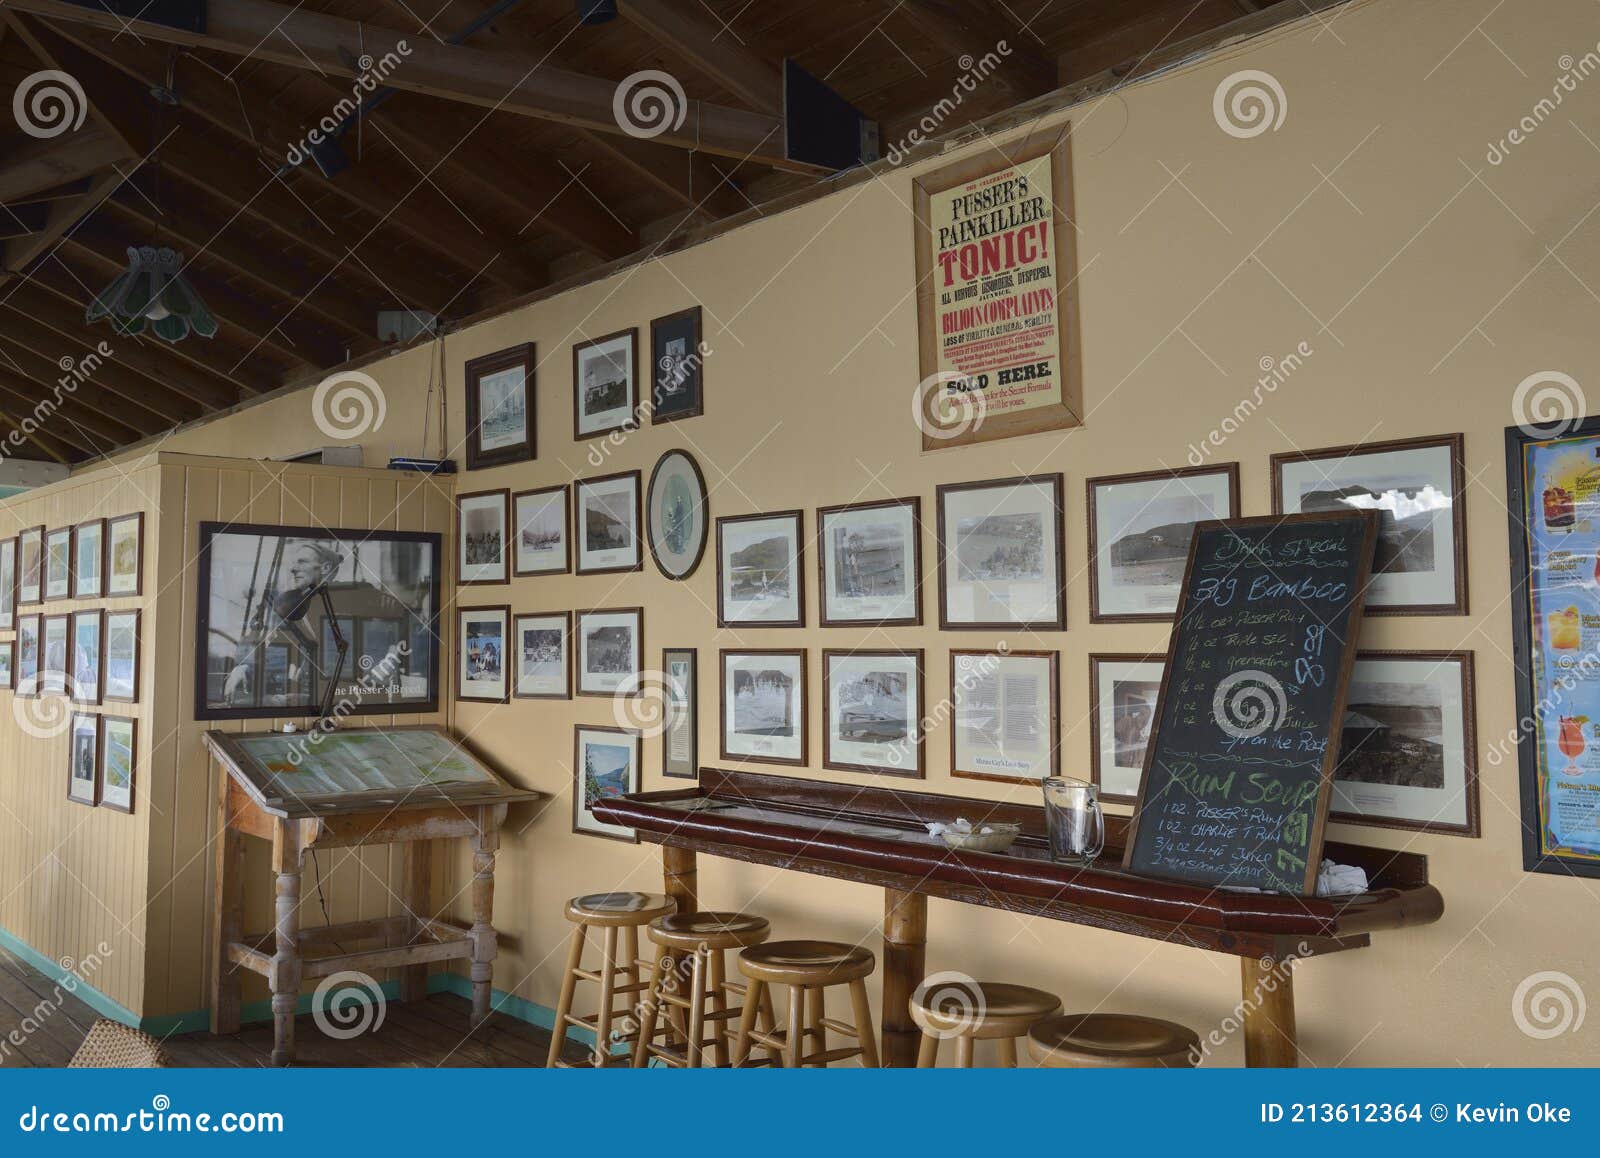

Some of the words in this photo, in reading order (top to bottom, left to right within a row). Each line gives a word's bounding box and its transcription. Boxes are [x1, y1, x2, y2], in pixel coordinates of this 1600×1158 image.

[938, 196, 1046, 250] PAINKILLER
[952, 175, 1029, 221] PUSSER'S
[938, 221, 1048, 287] TONIC!
[947, 374, 989, 396] SOLD
